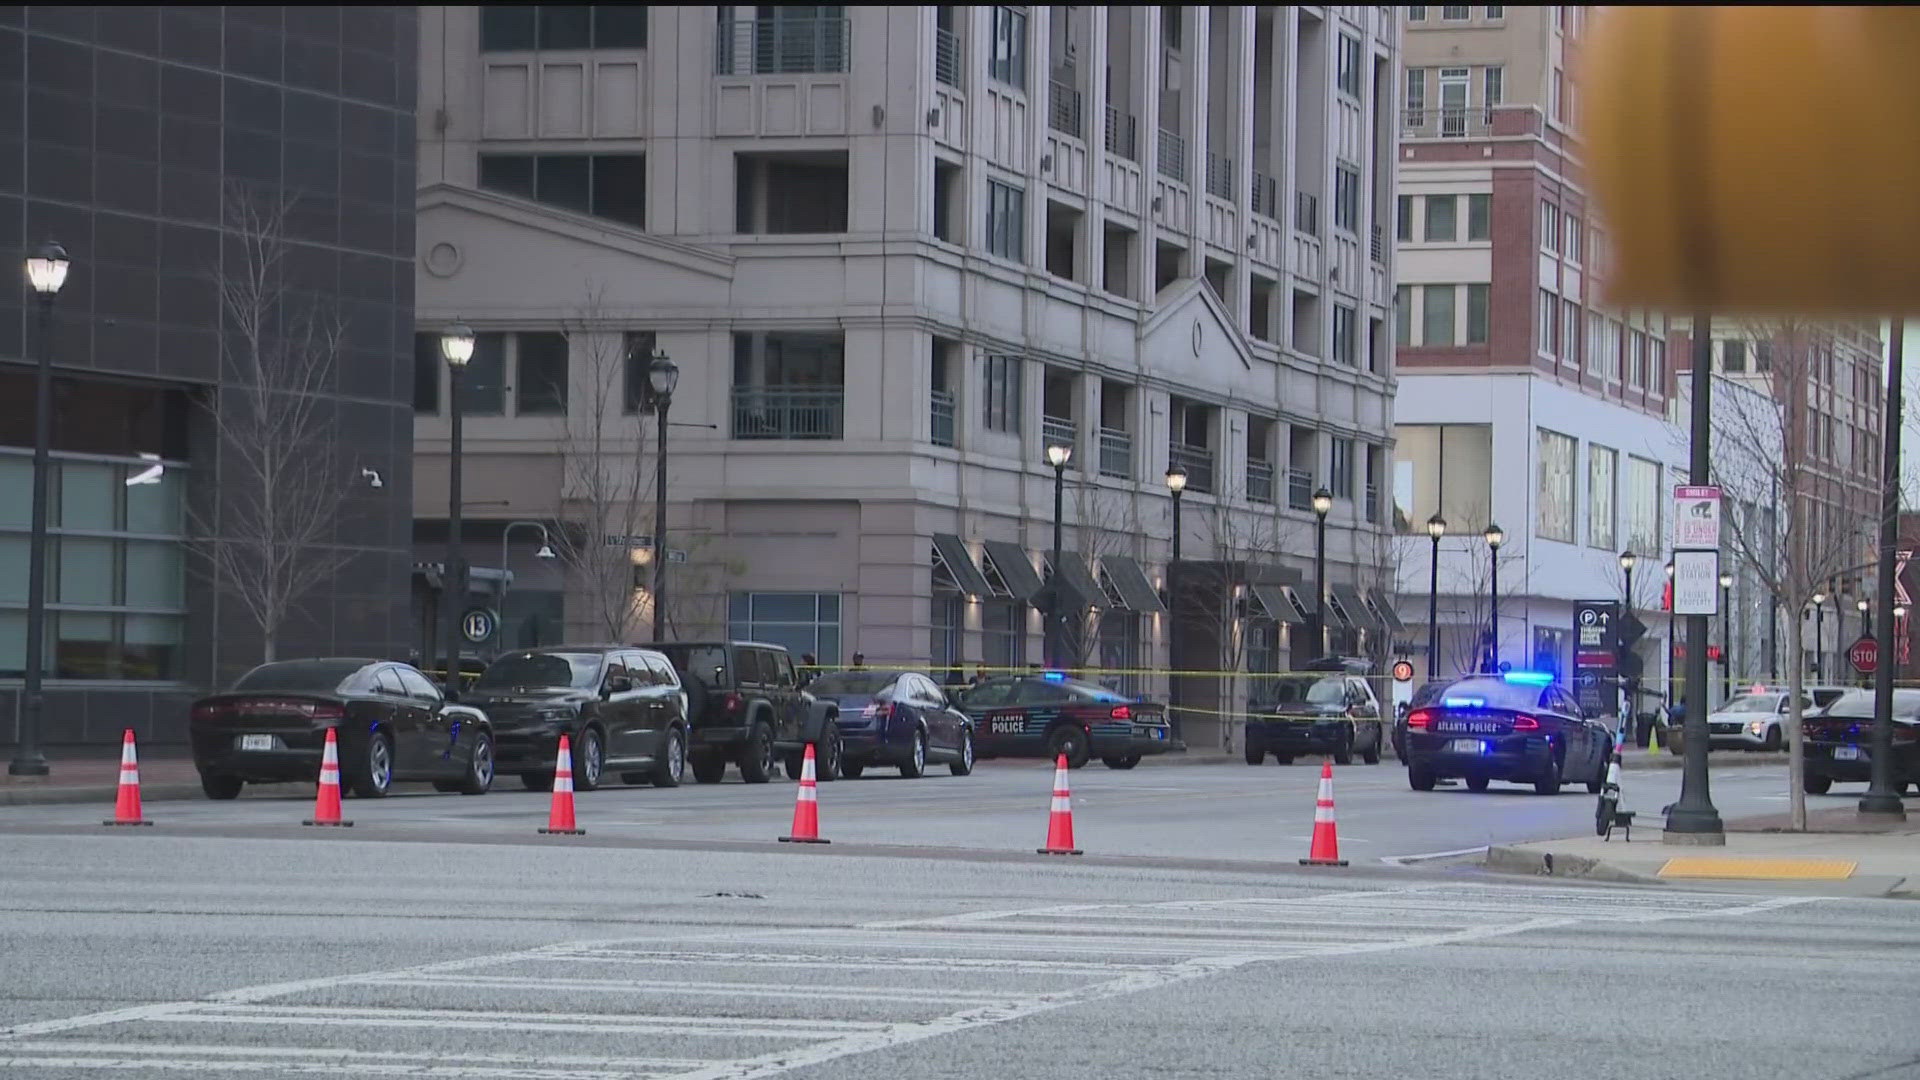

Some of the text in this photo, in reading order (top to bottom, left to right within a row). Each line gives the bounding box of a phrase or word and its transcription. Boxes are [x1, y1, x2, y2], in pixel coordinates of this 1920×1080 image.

[470, 615, 486, 636] 13
[992, 722, 1024, 733] POLICE
[1437, 721, 1497, 733] ATLANTA POLICE
